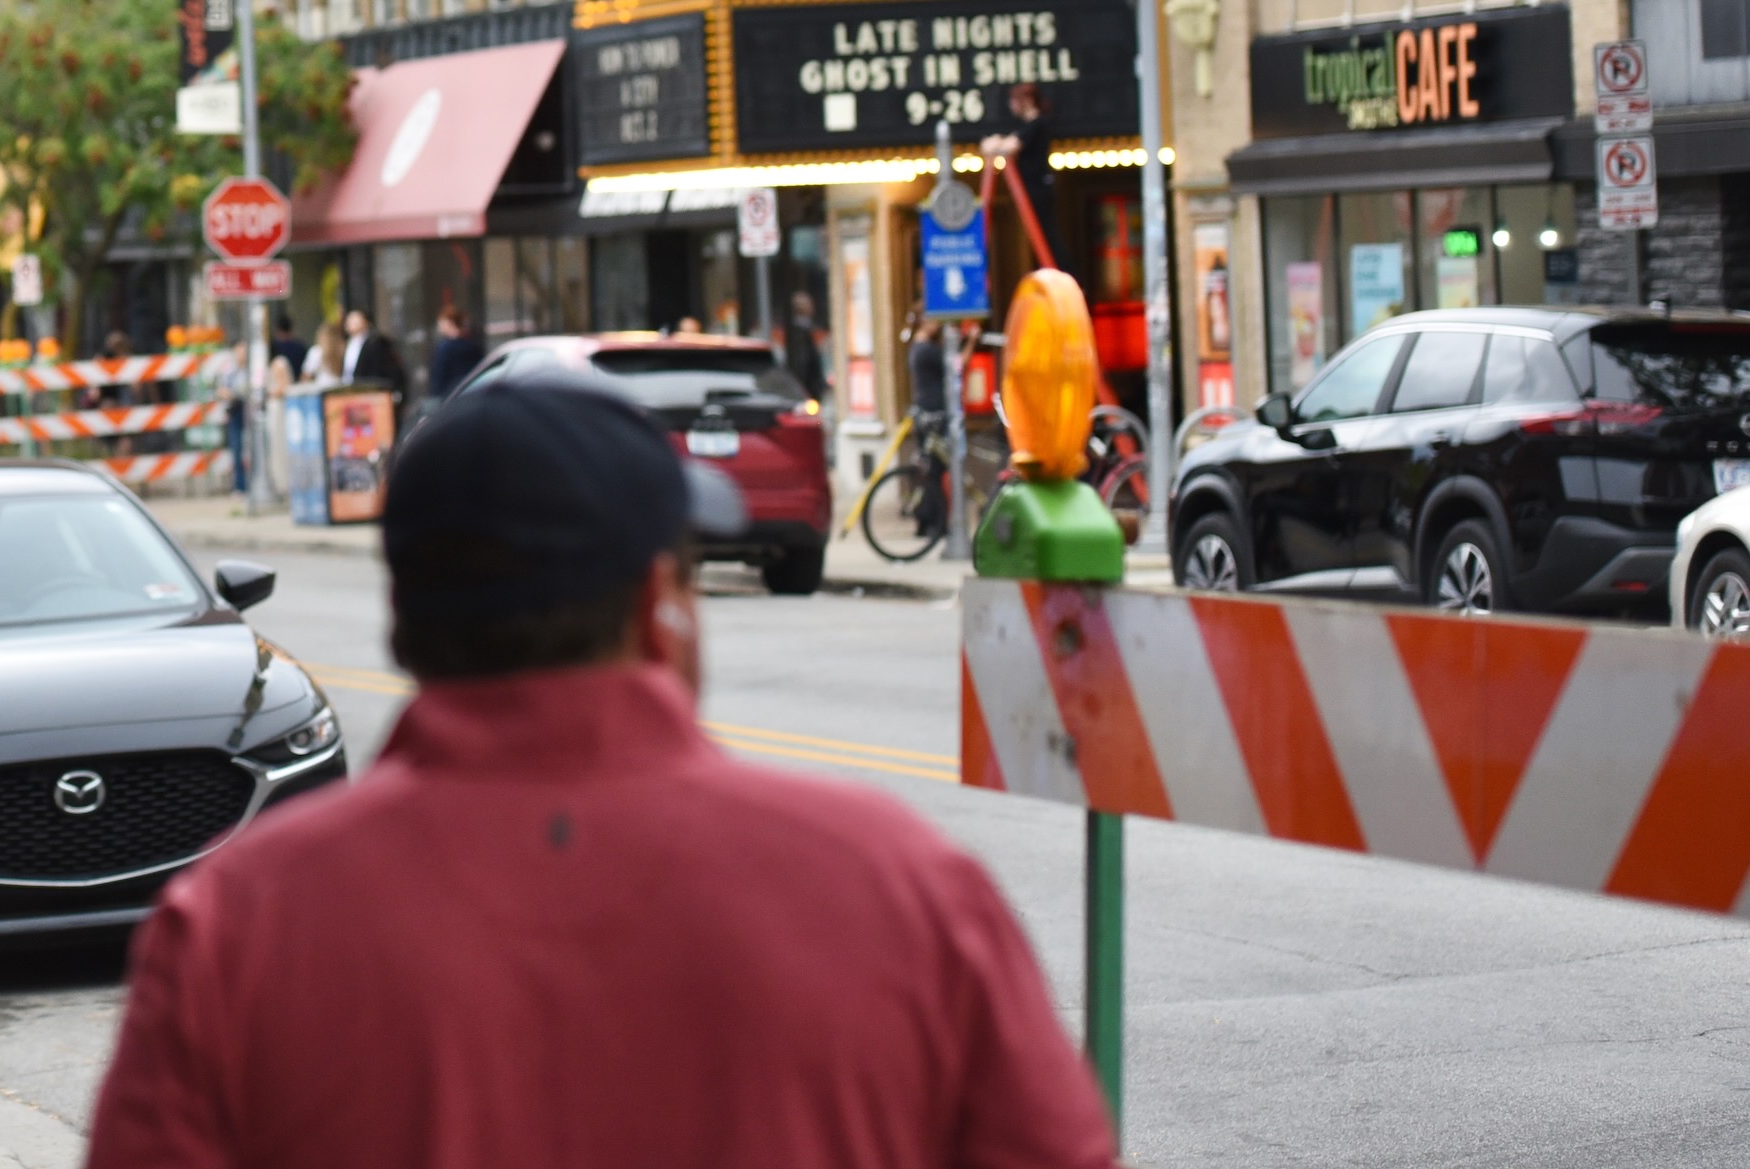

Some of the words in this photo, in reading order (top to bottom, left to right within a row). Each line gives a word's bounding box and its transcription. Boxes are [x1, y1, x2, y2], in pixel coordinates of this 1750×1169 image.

[834, 19, 919, 55] LATE
[932, 12, 1056, 50] NIGHTS
[800, 56, 911, 93] GHOST
[923, 54, 961, 87] IN
[973, 48, 1079, 85] SHELL
[1305, 30, 1395, 115] tropical
[1396, 23, 1479, 123] CAFE
[905, 89, 985, 124] 9-26
[212, 203, 280, 238] STOP
